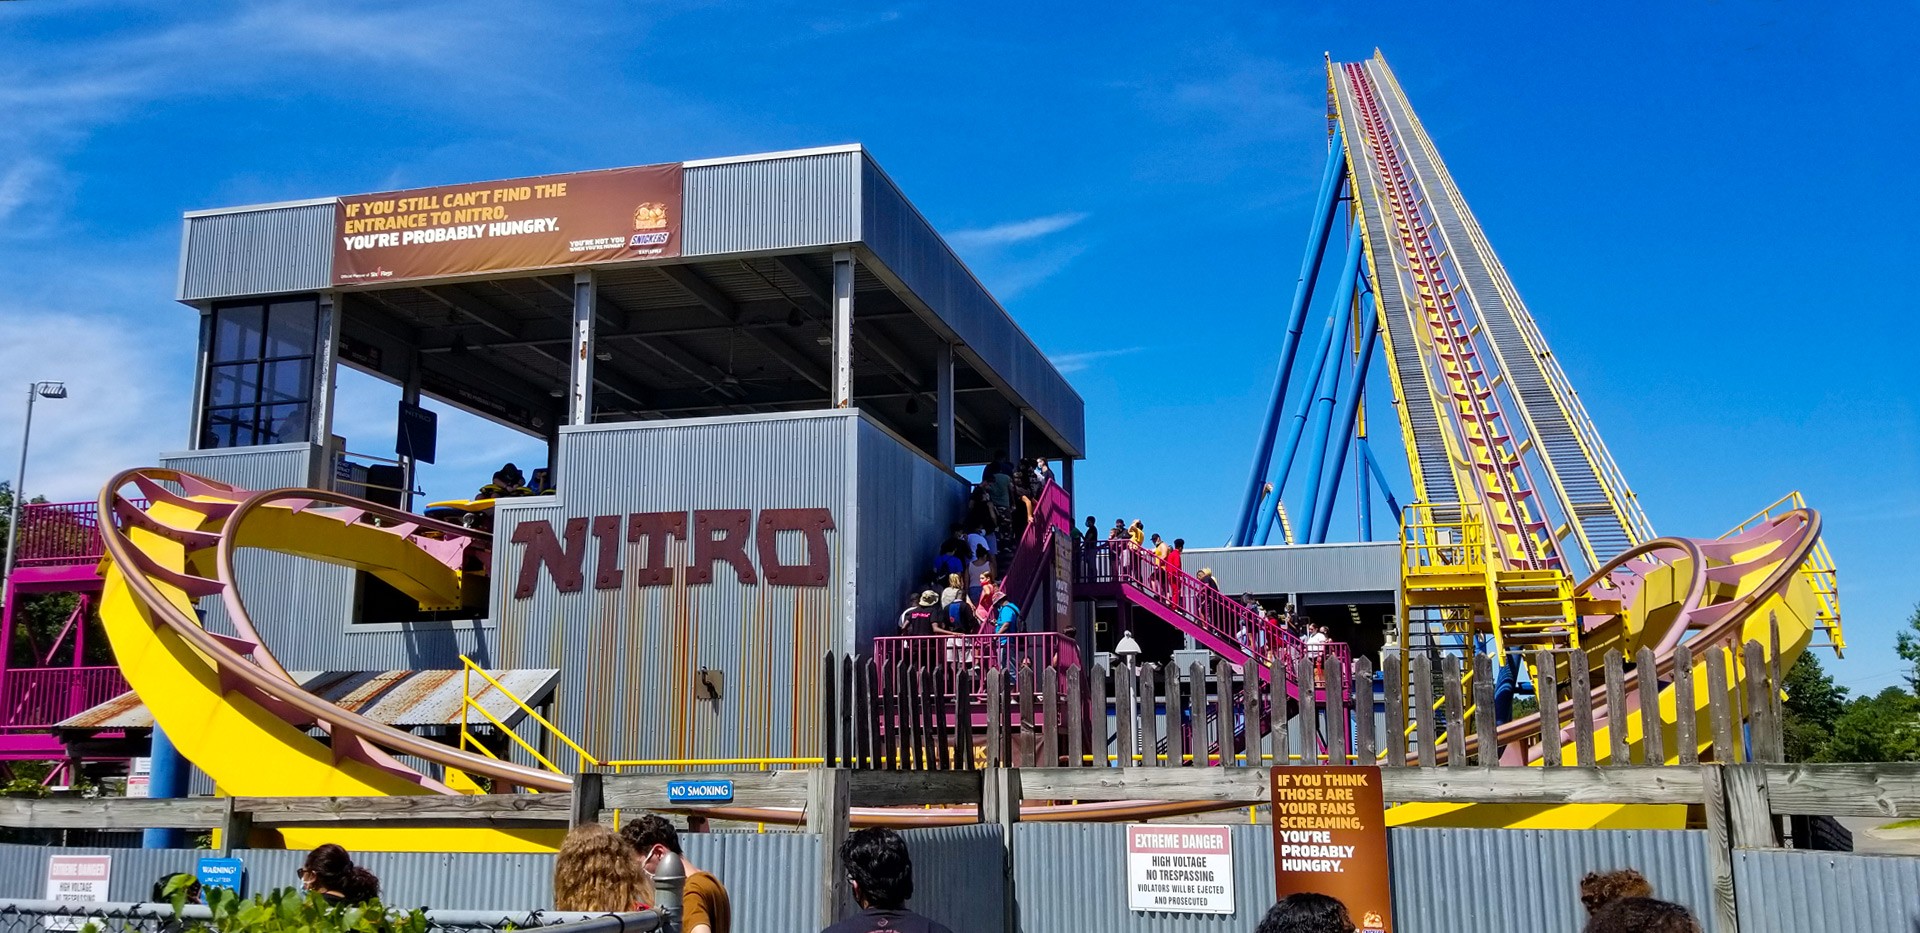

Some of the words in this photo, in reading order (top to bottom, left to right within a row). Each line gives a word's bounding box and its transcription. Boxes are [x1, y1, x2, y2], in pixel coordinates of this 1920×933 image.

[346, 203, 360, 217] IF
[363, 200, 395, 215] YOU
[398, 196, 439, 212] STILL
[443, 190, 491, 207] CAN'T
[493, 187, 531, 203] FIND
[534, 183, 567, 198] THE
[344, 213, 427, 234] ENTRANCE
[430, 211, 451, 225] TO
[454, 205, 508, 223] NITRO,
[343, 232, 399, 250] YOU'RE
[402, 224, 486, 245] PROBABLY
[489, 217, 559, 237] HUNGRY.
[610, 236, 625, 244] YOU
[631, 233, 667, 245] SNICKERS
[511, 508, 837, 600] NITRO
[1278, 774, 1290, 786] IF
[1292, 774, 1321, 786] YOU
[1323, 774, 1368, 786] THINK
[671, 785, 685, 796] NO
[687, 785, 728, 796] SMOKING
[1278, 788, 1323, 800] THOSE
[1325, 788, 1354, 800] ARE
[1279, 802, 1317, 814] YOUR
[1320, 802, 1356, 814] FANS
[1280, 816, 1364, 831] SCREAMING,
[1135, 834, 1179, 849] EXTREME
[1182, 834, 1223, 849] DANGER
[1280, 830, 1331, 843] YOU'RE
[1281, 845, 1355, 858] PROBABLY
[1152, 856, 1171, 867] HIGH
[1173, 856, 1207, 867] VOLTAGE
[1282, 859, 1344, 872] HUNGRY.
[1146, 869, 1157, 880] NO
[1159, 870, 1214, 882] TRESPASSING
[1137, 884, 1170, 893] VIOLATORS
[1171, 885, 1186, 893] WILL
[1187, 885, 1195, 893] BE
[1197, 885, 1224, 894] EJECTED
[1154, 896, 1167, 905] AND
[1168, 896, 1208, 906] PROSECUTED
